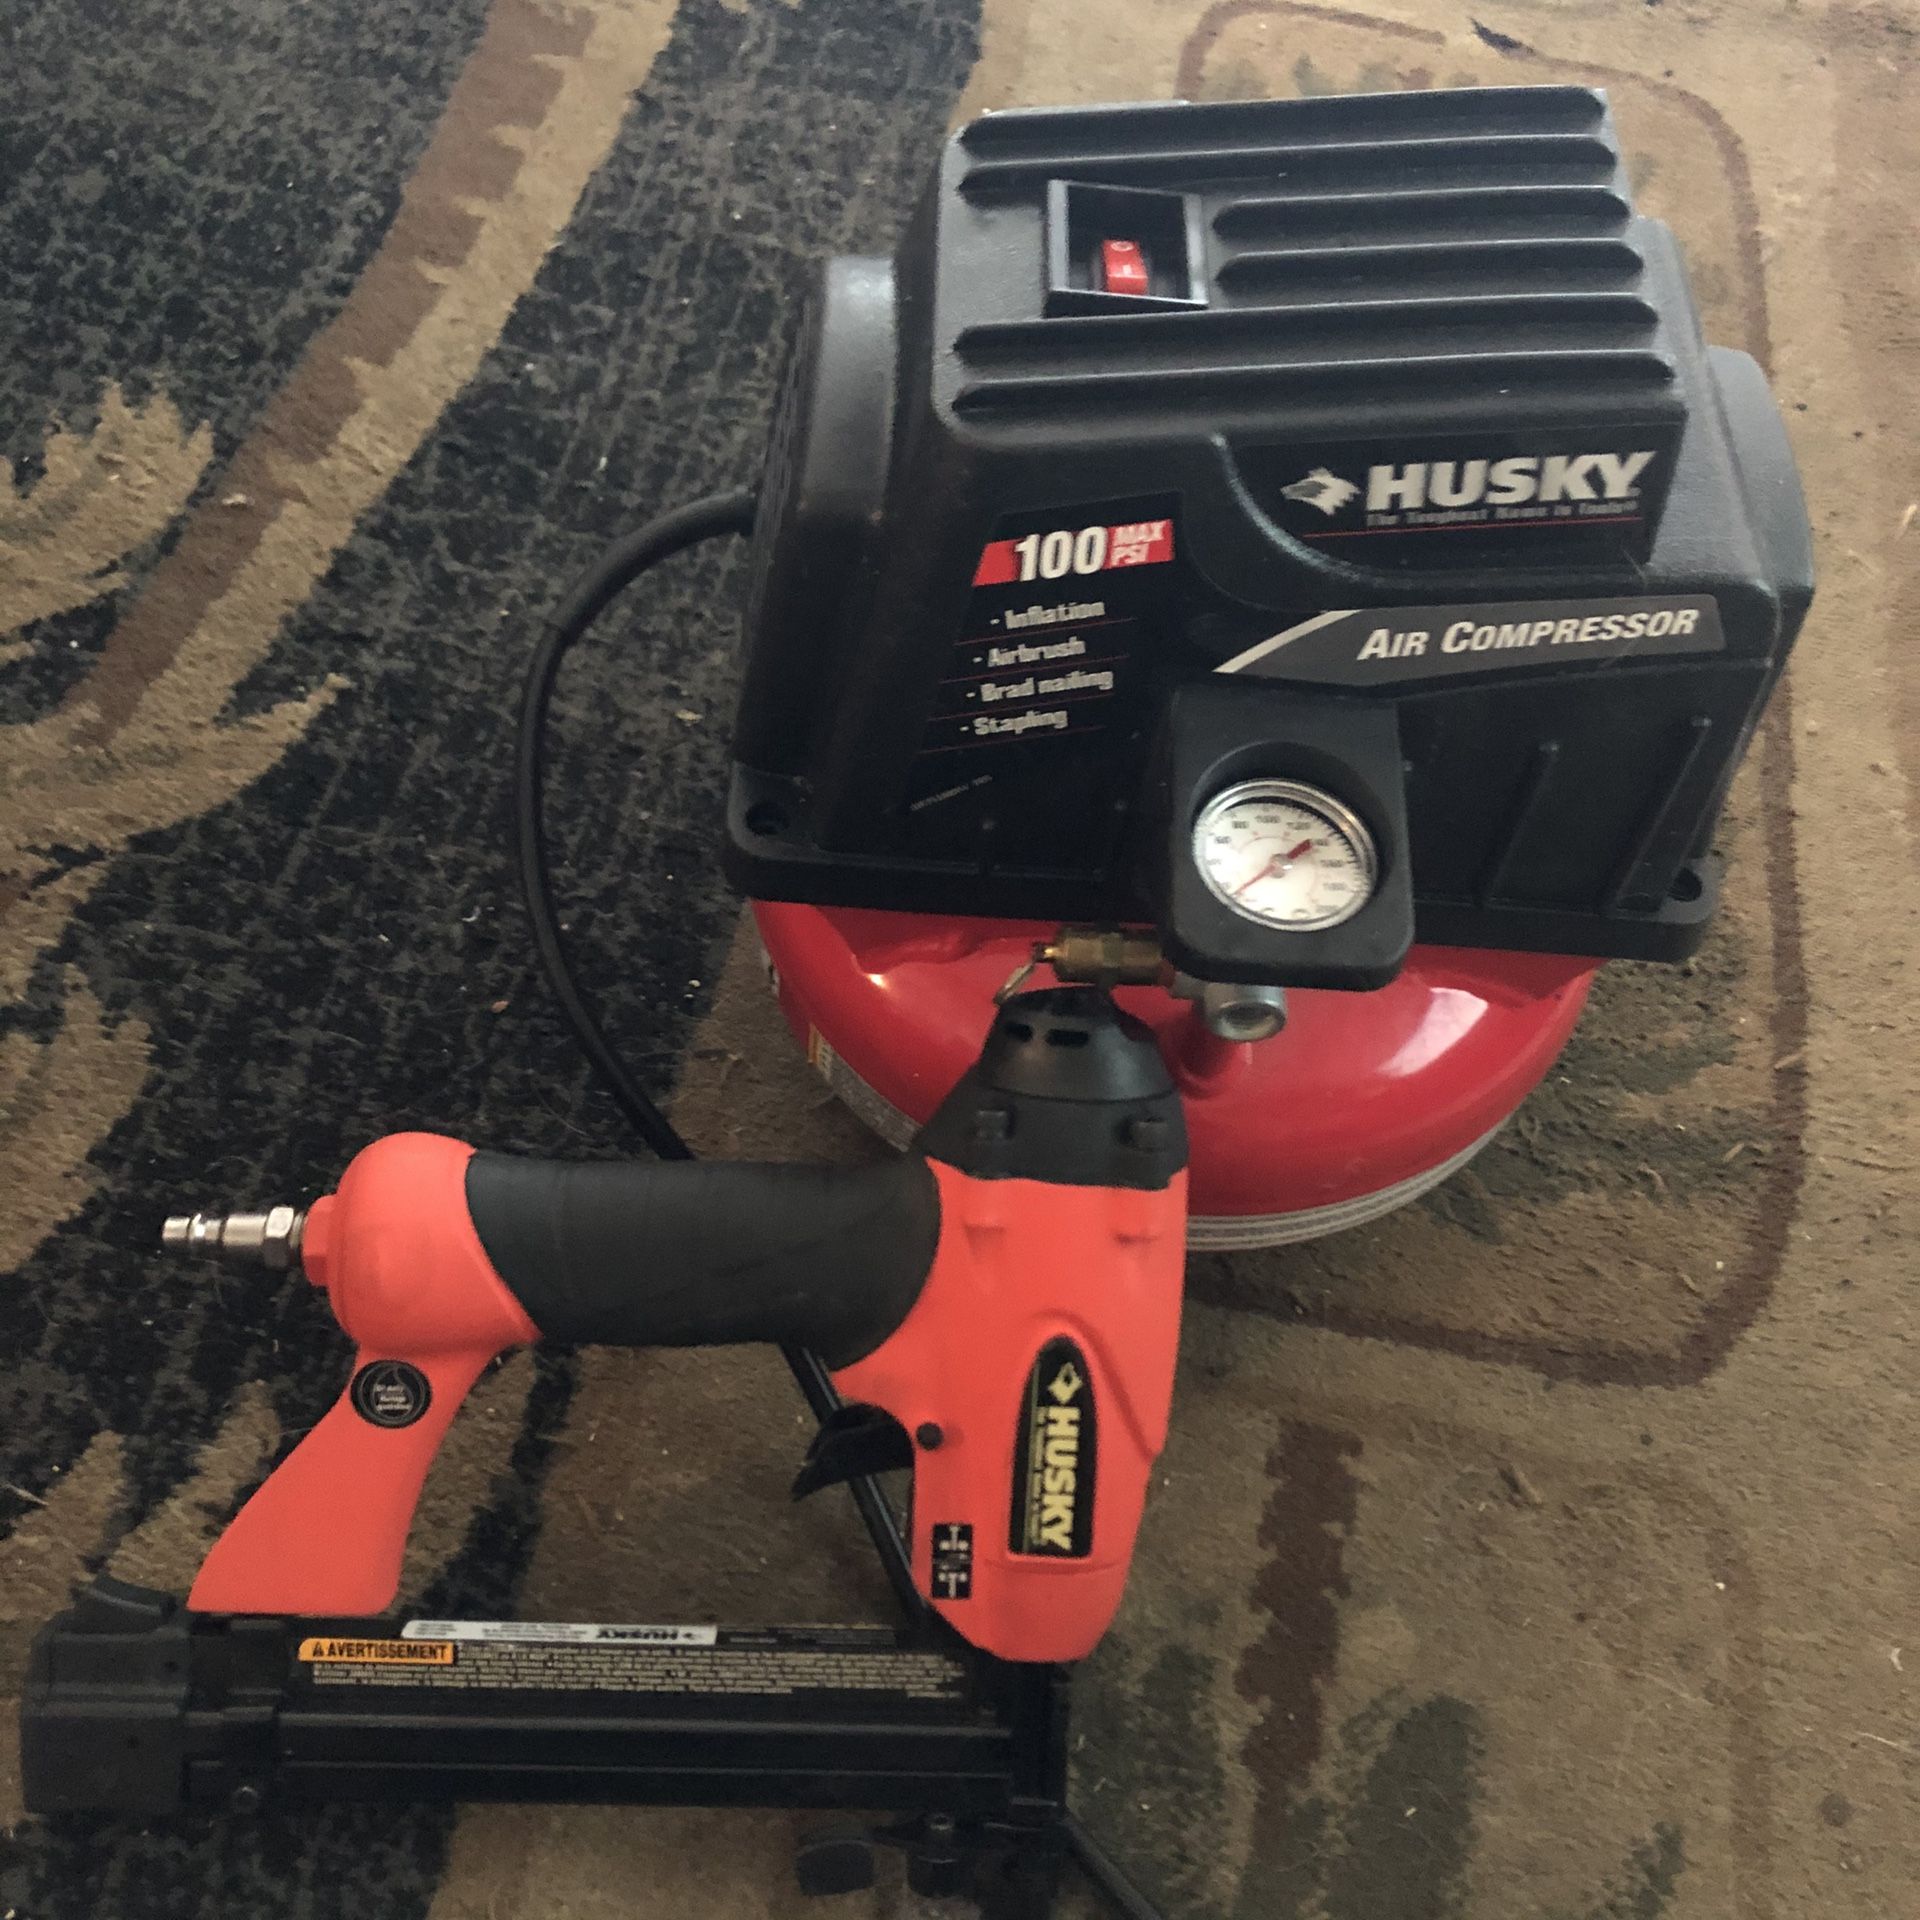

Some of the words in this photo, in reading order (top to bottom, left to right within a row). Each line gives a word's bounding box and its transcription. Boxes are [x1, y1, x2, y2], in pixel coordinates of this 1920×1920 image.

[1366, 450, 1657, 511] HUSKY
[1112, 521, 1166, 546] MAX
[1015, 526, 1108, 582] 100
[1110, 543, 1150, 567] PSI
[1004, 601, 1105, 630] Inflation
[1356, 628, 1430, 661] AIR
[1440, 608, 1700, 654] COMPRESSOR
[988, 636, 1086, 668] Airbrush
[981, 677, 1035, 702] Brad
[973, 710, 1068, 735] Stapling
[1041, 1406, 1081, 1550] HUSKY
[327, 1642, 447, 1660] AVERTISSEMENT
